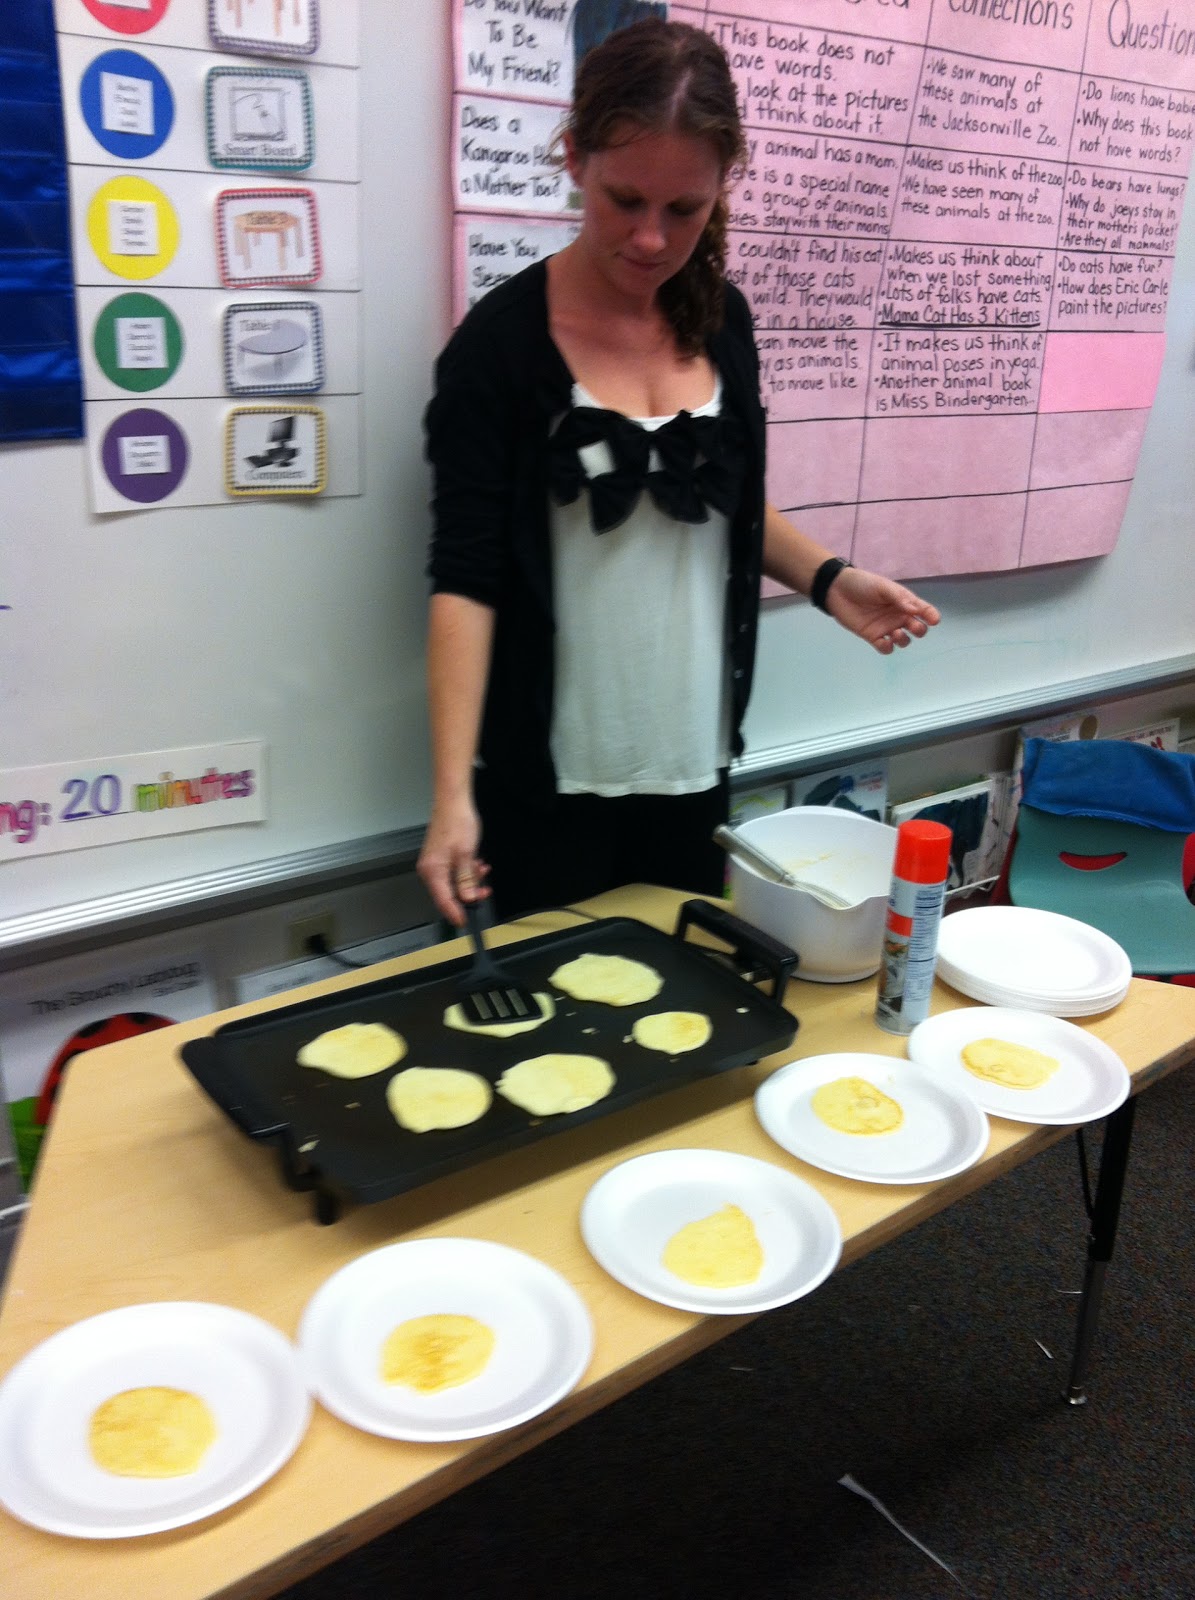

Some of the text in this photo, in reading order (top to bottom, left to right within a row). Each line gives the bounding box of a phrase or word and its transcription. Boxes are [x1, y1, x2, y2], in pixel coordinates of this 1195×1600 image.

[486, 20, 538, 48] To Be
[715, 22, 895, 65] This book does not
[468, 52, 560, 86] My Friend?
[931, 58, 1042, 96] We saw many of
[747, 78, 907, 116] look at the pictures
[922, 81, 1042, 113] these animals at
[1086, 81, 1164, 109] Do lions have
[462, 105, 498, 132] Does
[757, 104, 808, 124] think
[813, 112, 861, 132] about
[917, 107, 937, 128] the
[943, 111, 1032, 139] Jacksonville
[1082, 109, 1193, 141] Why does this book
[765, 139, 819, 159] animal
[825, 139, 851, 162] has
[855, 151, 863, 163] a
[1079, 136, 1182, 164] not have words?
[910, 154, 1047, 183] Makes us think of the
[474, 173, 526, 196] Mother
[764, 166, 890, 197] is a special name
[906, 176, 1040, 206] We have seen many of
[1072, 170, 1087, 186] Do
[1092, 173, 1122, 192] bears
[1128, 177, 1151, 194] have
[743, 190, 832, 216] a group of
[901, 197, 930, 215] these
[935, 203, 990, 219] animals
[998, 205, 1011, 220] at
[1014, 206, 1034, 223] the
[1069, 192, 1176, 225] Why do joeys stay in
[763, 211, 852, 234] stay with their
[1067, 213, 1095, 230] their
[469, 234, 506, 256] Have
[808, 240, 838, 262] find
[841, 242, 860, 261] his
[1064, 231, 1082, 246] Are
[1084, 231, 1107, 251] they
[1111, 236, 1122, 249] all
[893, 246, 1043, 270] Makes us think about
[1062, 256, 1162, 274] Do cats have fur?
[752, 264, 854, 287] of those cats
[888, 268, 981, 286] when we lost
[1061, 277, 1168, 296] How does Eric Carle
[797, 287, 872, 315] They would
[886, 286, 913, 301] Lots
[917, 285, 935, 301] of
[937, 284, 971, 304] folks
[977, 290, 1007, 303] have
[882, 303, 1041, 325] Mama Cat Has 3 Kittens
[1058, 300, 1089, 317] paint
[1093, 297, 1112, 315] the
[768, 312, 783, 327] in
[788, 317, 799, 329] a
[788, 336, 827, 348] move
[833, 333, 858, 351] the
[884, 331, 1042, 352] It makes us think of
[774, 357, 793, 371] as
[881, 350, 938, 372] animal
[943, 356, 984, 378] poses
[990, 356, 1004, 370] in
[769, 372, 857, 393] to move like
[880, 372, 1031, 391] Another animal book
[876, 392, 928, 411] is Miss
[61, 774, 123, 820] 20
[135, 767, 256, 812] minutes
